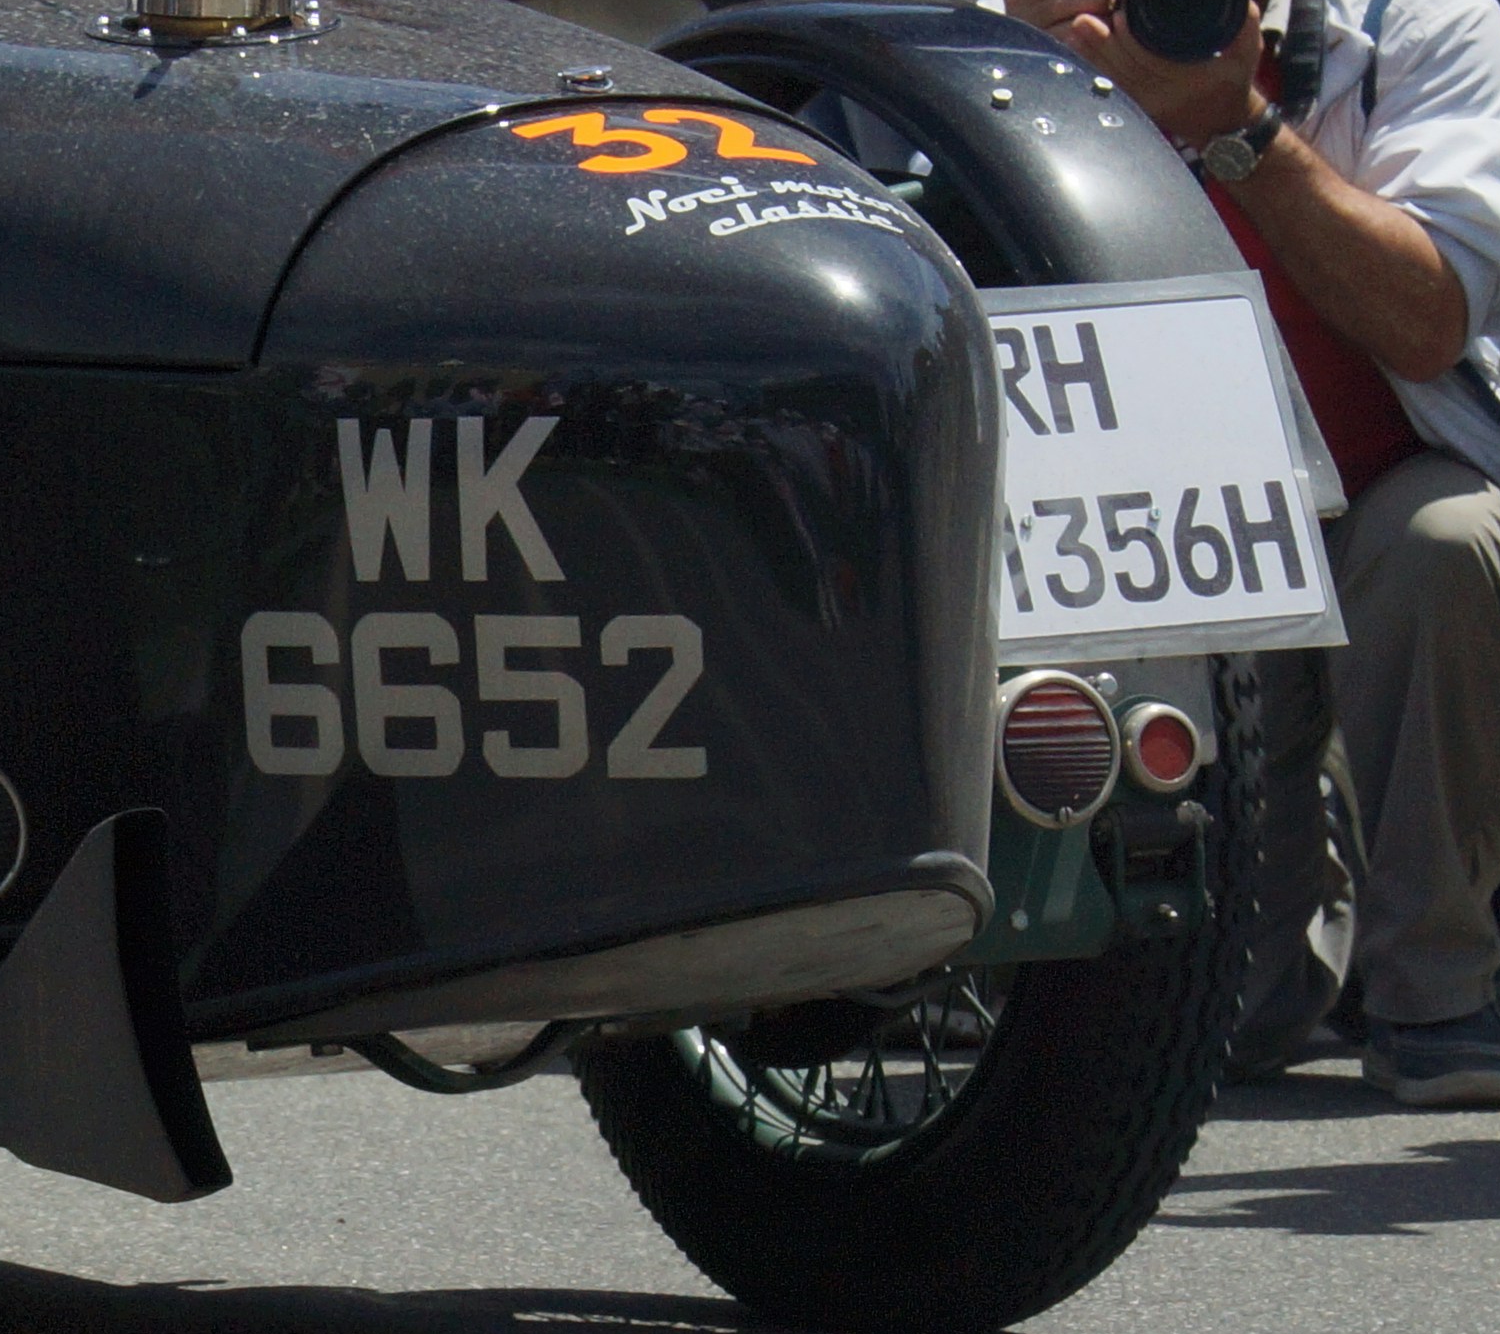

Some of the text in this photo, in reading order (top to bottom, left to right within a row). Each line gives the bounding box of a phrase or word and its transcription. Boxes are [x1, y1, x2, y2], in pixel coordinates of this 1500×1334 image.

[511, 108, 818, 174] 32
[625, 176, 758, 236] Noci
[709, 199, 905, 237] classic
[336, 414, 566, 583] WK
[240, 611, 709, 779] 6652
